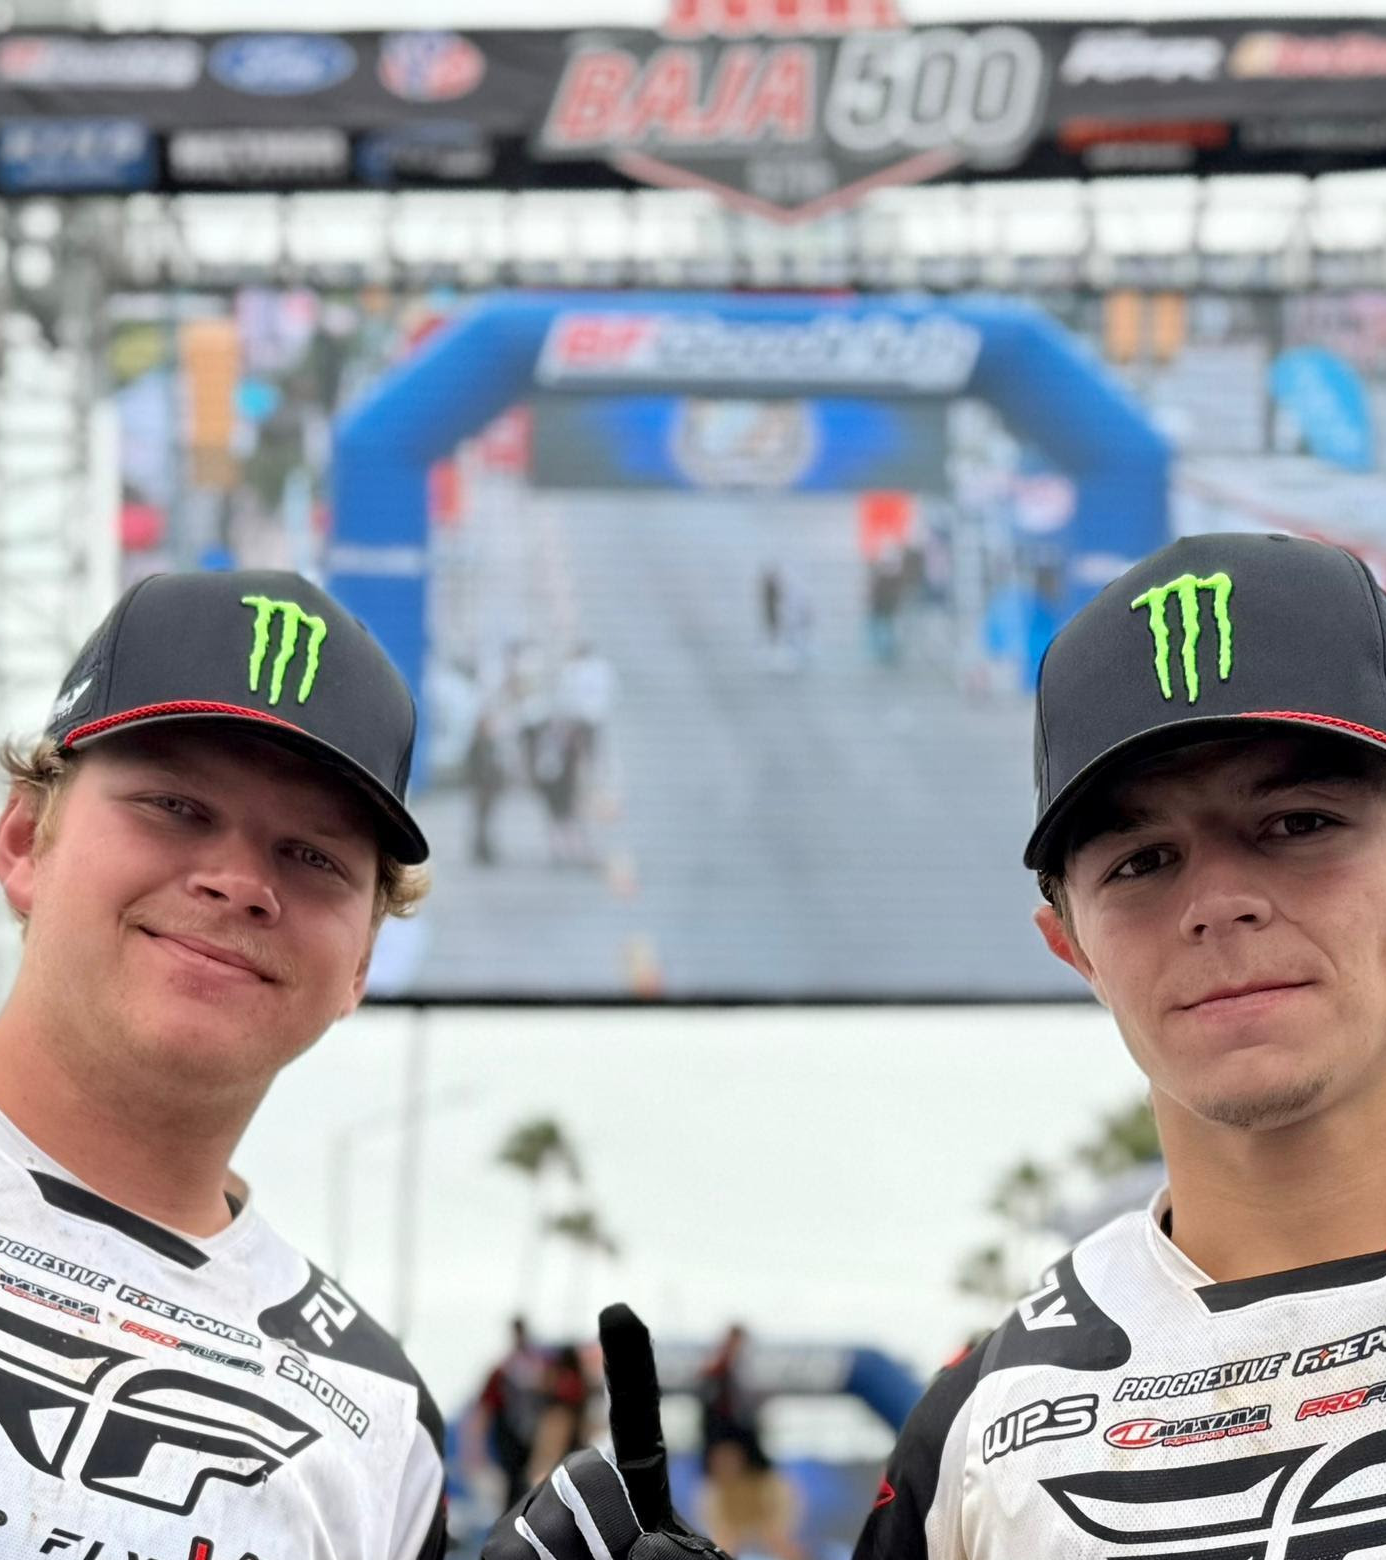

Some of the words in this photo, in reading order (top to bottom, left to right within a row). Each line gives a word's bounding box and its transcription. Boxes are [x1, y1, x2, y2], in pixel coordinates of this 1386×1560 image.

[825, 25, 1045, 158] 500
[277, 1355, 370, 1440] SHOWA
[1113, 1352, 1285, 1402] PROGRESSIVE
[983, 1394, 1099, 1464] WPS
